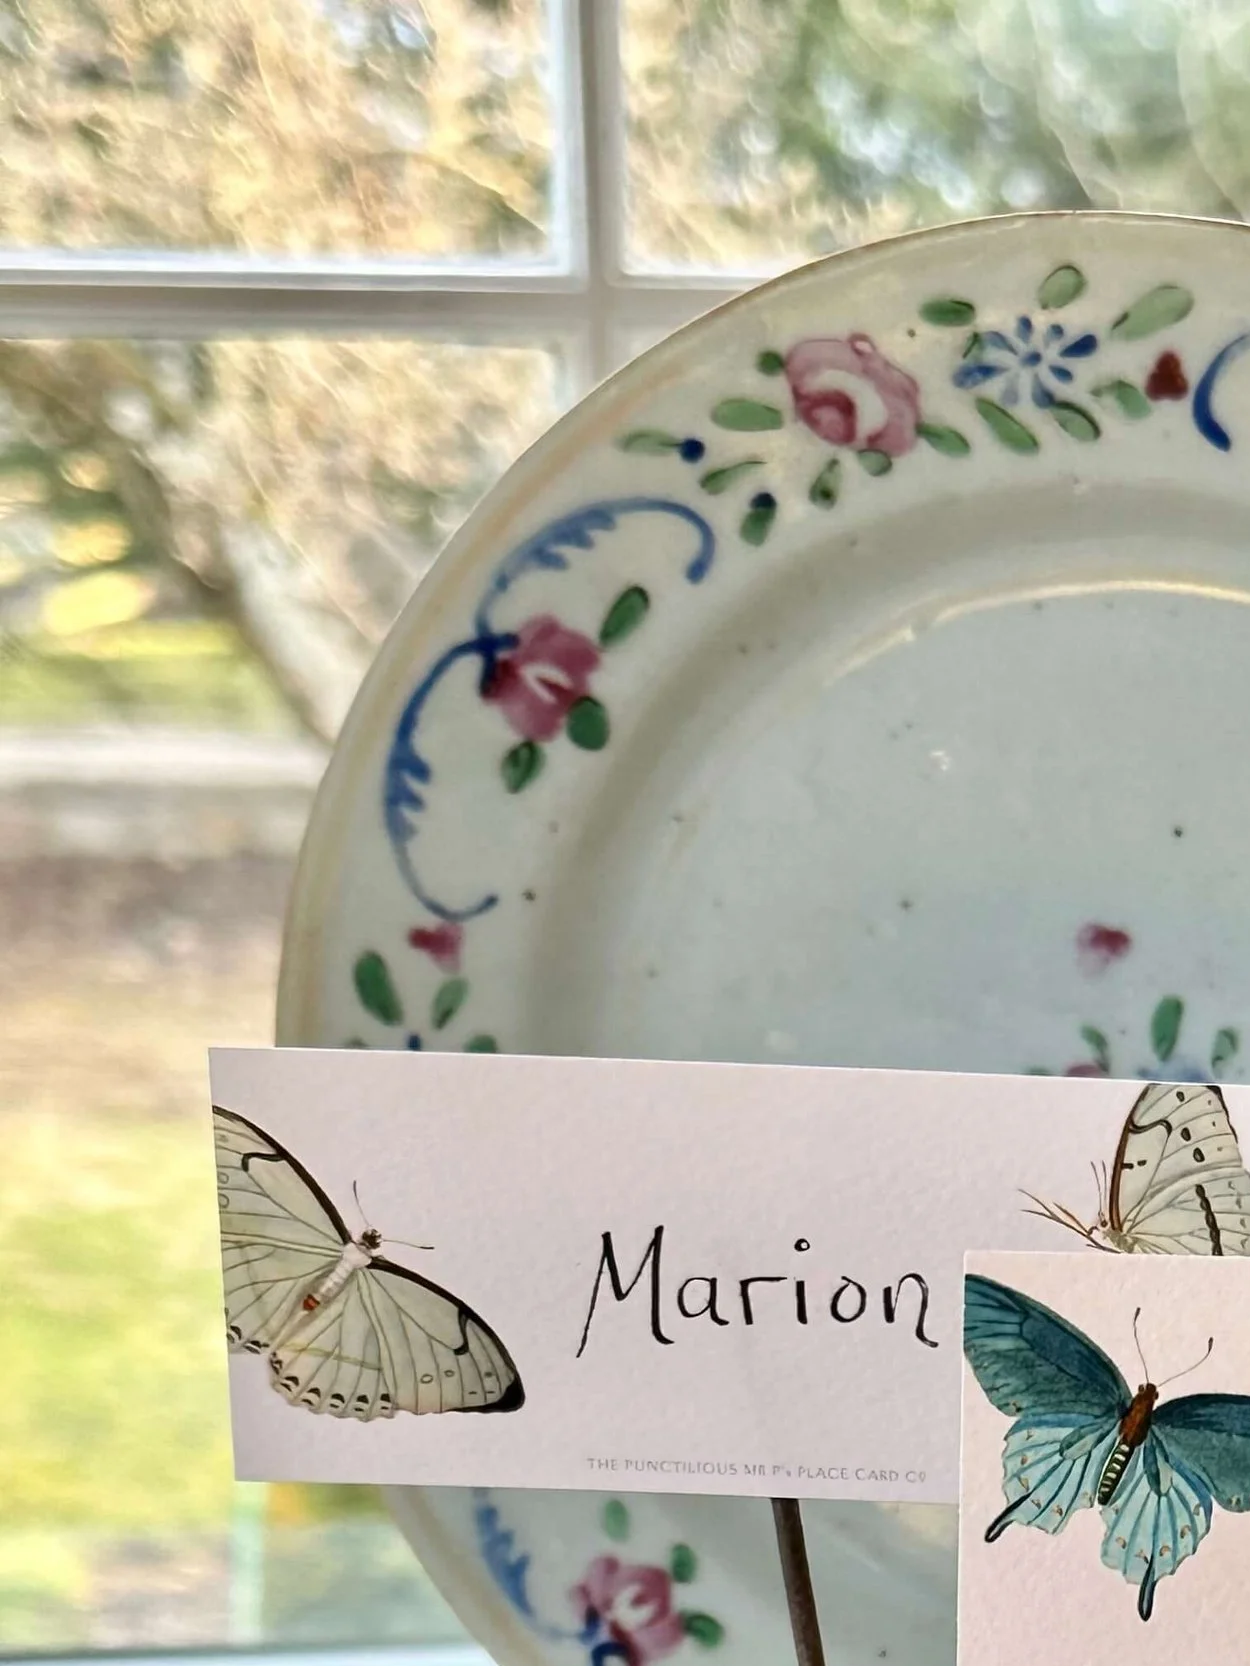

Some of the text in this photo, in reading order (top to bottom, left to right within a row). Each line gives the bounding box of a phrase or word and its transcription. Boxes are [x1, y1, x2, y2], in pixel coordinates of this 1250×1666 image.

[576, 1225, 939, 1358] Marion
[587, 1457, 618, 1470] THE
[624, 1459, 738, 1475] PUNCTILIOUS
[798, 1466, 849, 1480] PLACE
[854, 1467, 899, 1482] CARD
